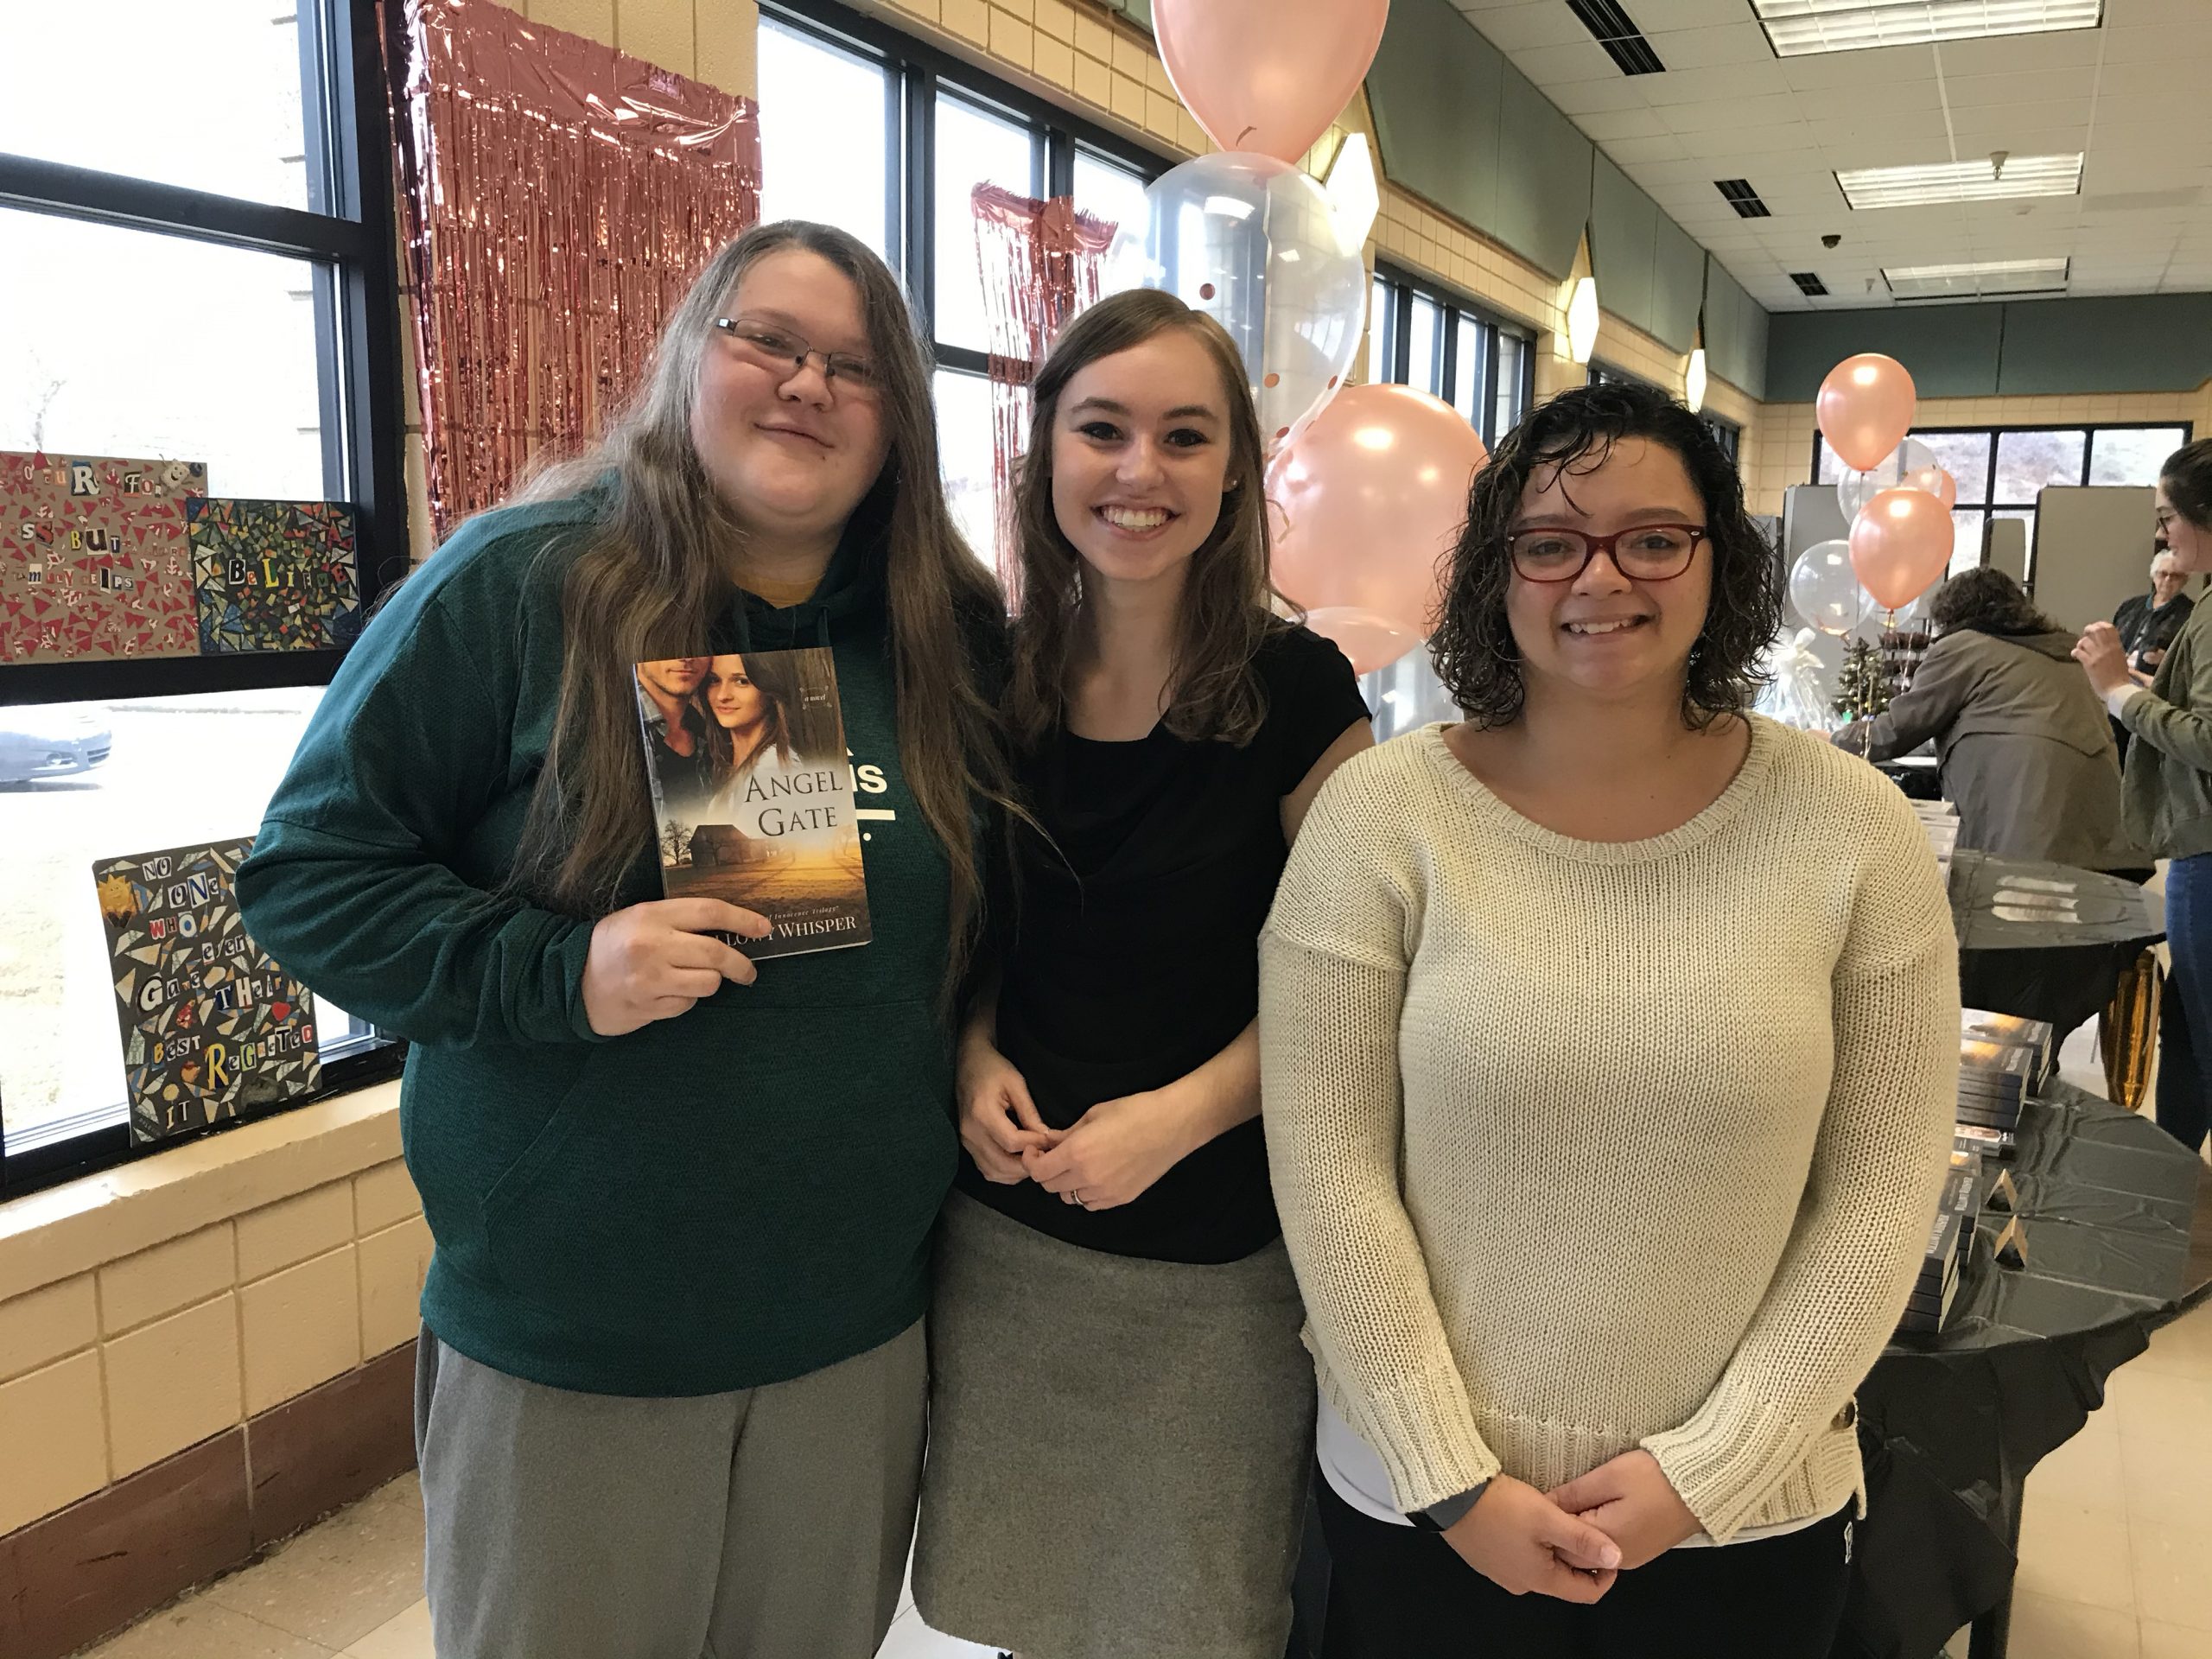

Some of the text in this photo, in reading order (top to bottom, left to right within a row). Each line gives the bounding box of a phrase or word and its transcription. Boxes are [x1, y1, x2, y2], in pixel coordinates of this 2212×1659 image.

[745, 771, 843, 803] ANGEL
[758, 807, 837, 836] GATE
[143, 857, 172, 880] NO
[149, 914, 197, 939] WHO
[778, 916, 856, 938] WHISPER
[166, 1102, 189, 1133] IT
